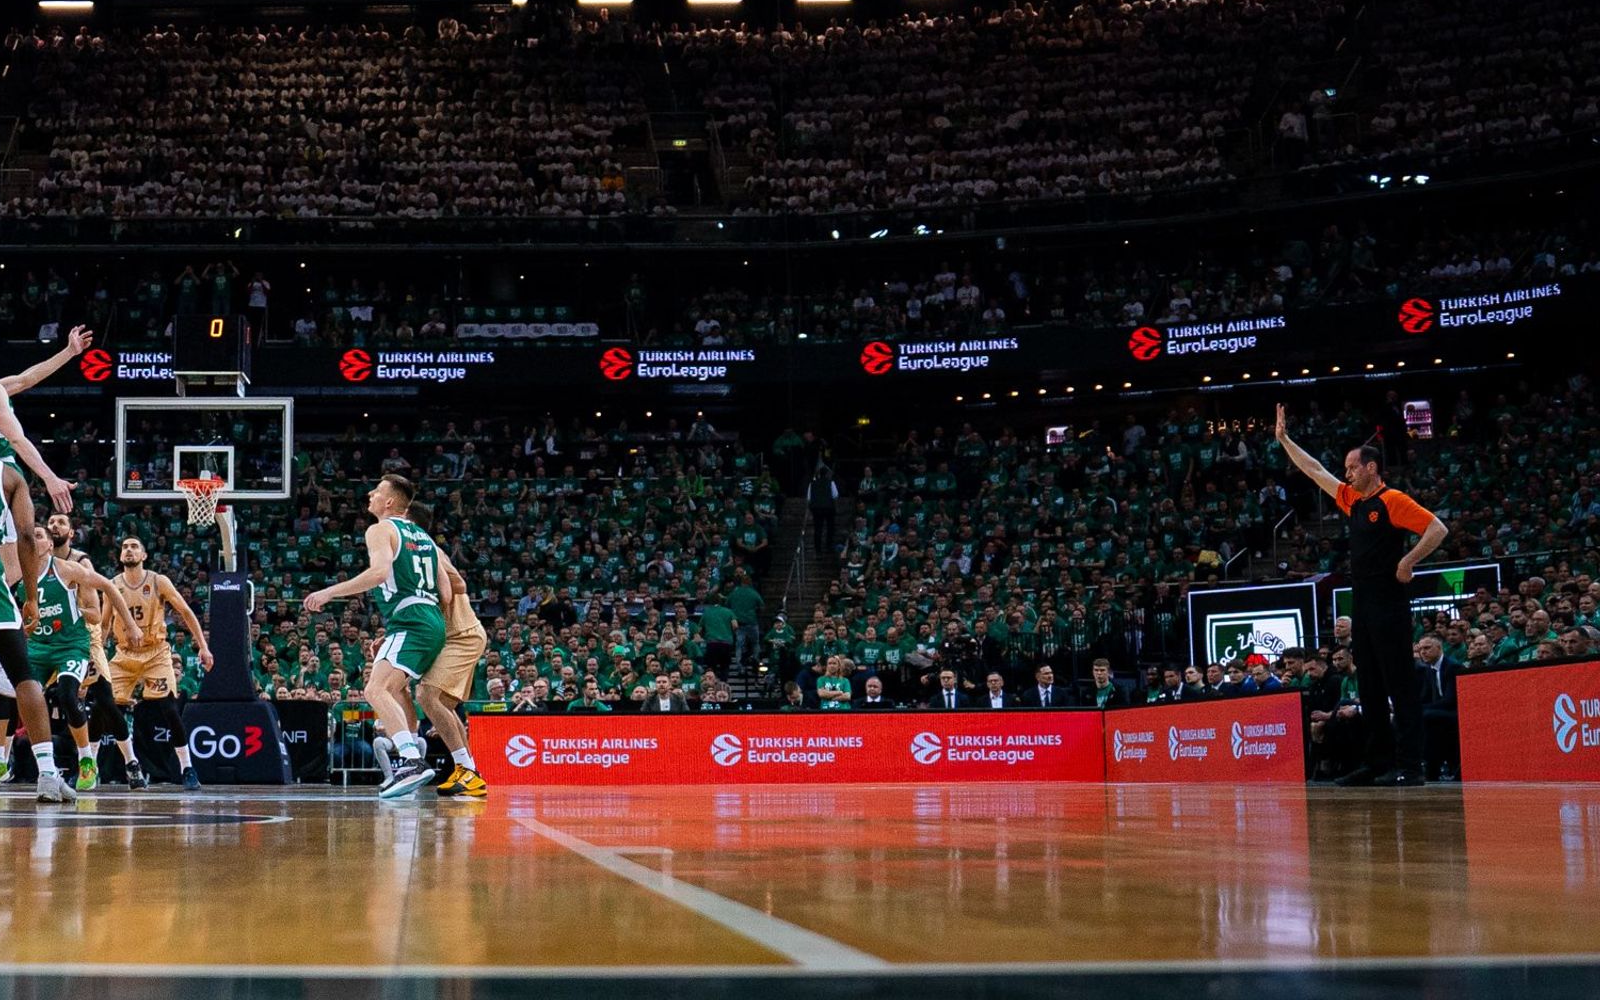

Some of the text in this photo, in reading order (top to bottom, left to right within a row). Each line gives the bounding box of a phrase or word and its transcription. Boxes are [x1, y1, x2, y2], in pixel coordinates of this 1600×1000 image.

[1440, 283, 1561, 311] TURKISH AIRLINES
[1440, 305, 1533, 327] EuroLeague
[210, 318, 224, 338] 0
[1167, 316, 1285, 338] TURKISH AIRLINES
[898, 338, 1018, 355] TURKISH AIRLINES
[1167, 335, 1256, 354] EuroLeague
[377, 352, 494, 363] TURKISH AIRLINES
[637, 350, 755, 362] TURKISH AIRLINES
[898, 355, 989, 372] EuroLeague
[376, 365, 466, 382] EuroLeague
[637, 363, 727, 381] EuroLeague
[412, 555, 435, 590] 51
[129, 605, 144, 620] 13
[1244, 723, 1286, 737] TURKISH AIRLINES
[189, 726, 264, 760] Go3
[542, 737, 658, 750] TURKISH AIRLINES
[748, 736, 863, 749] TURKISH AIRLINES
[948, 734, 1062, 747] TURKISH AIRLINES
[748, 750, 835, 767] EuroLeague
[947, 748, 1035, 765] EuroLeague
[1244, 741, 1276, 759] EuroLeague
[542, 752, 630, 769] EuroLeague
